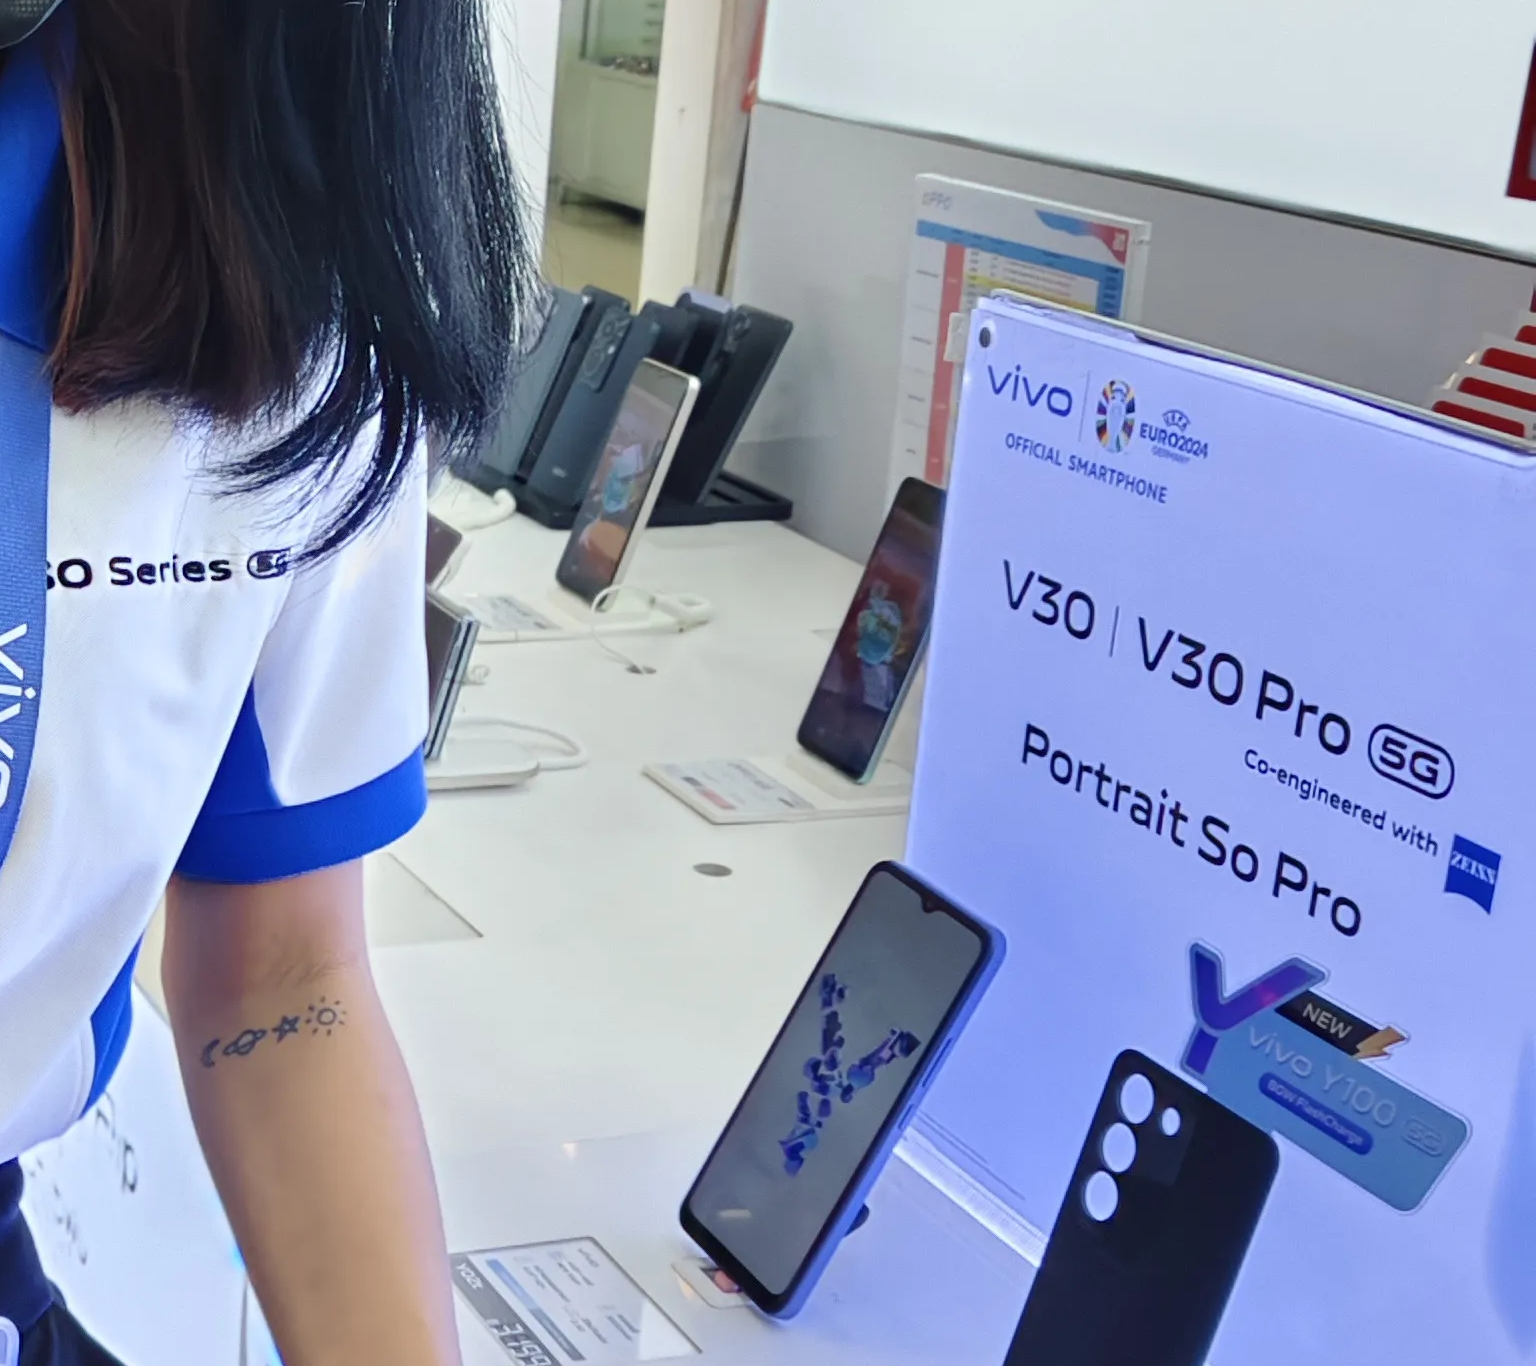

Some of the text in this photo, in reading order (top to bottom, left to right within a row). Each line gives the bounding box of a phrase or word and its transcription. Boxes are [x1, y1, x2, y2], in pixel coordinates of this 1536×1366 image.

[987, 363, 1073, 418] vivo
[1005, 432, 1169, 505] OFFICIAL SMARTPHONE
[108, 553, 233, 587] Series
[1003, 558, 1443, 789] V30 V30 Pro 5G
[1022, 723, 1362, 938] Portrait So Pro
[1243, 748, 1439, 859] Co-engineered with
[1450, 849, 1497, 887] ZEISS
[1302, 1002, 1354, 1040] NEW
[1248, 1026, 1313, 1078] vivo
[1322, 1063, 1396, 1128] Y100
